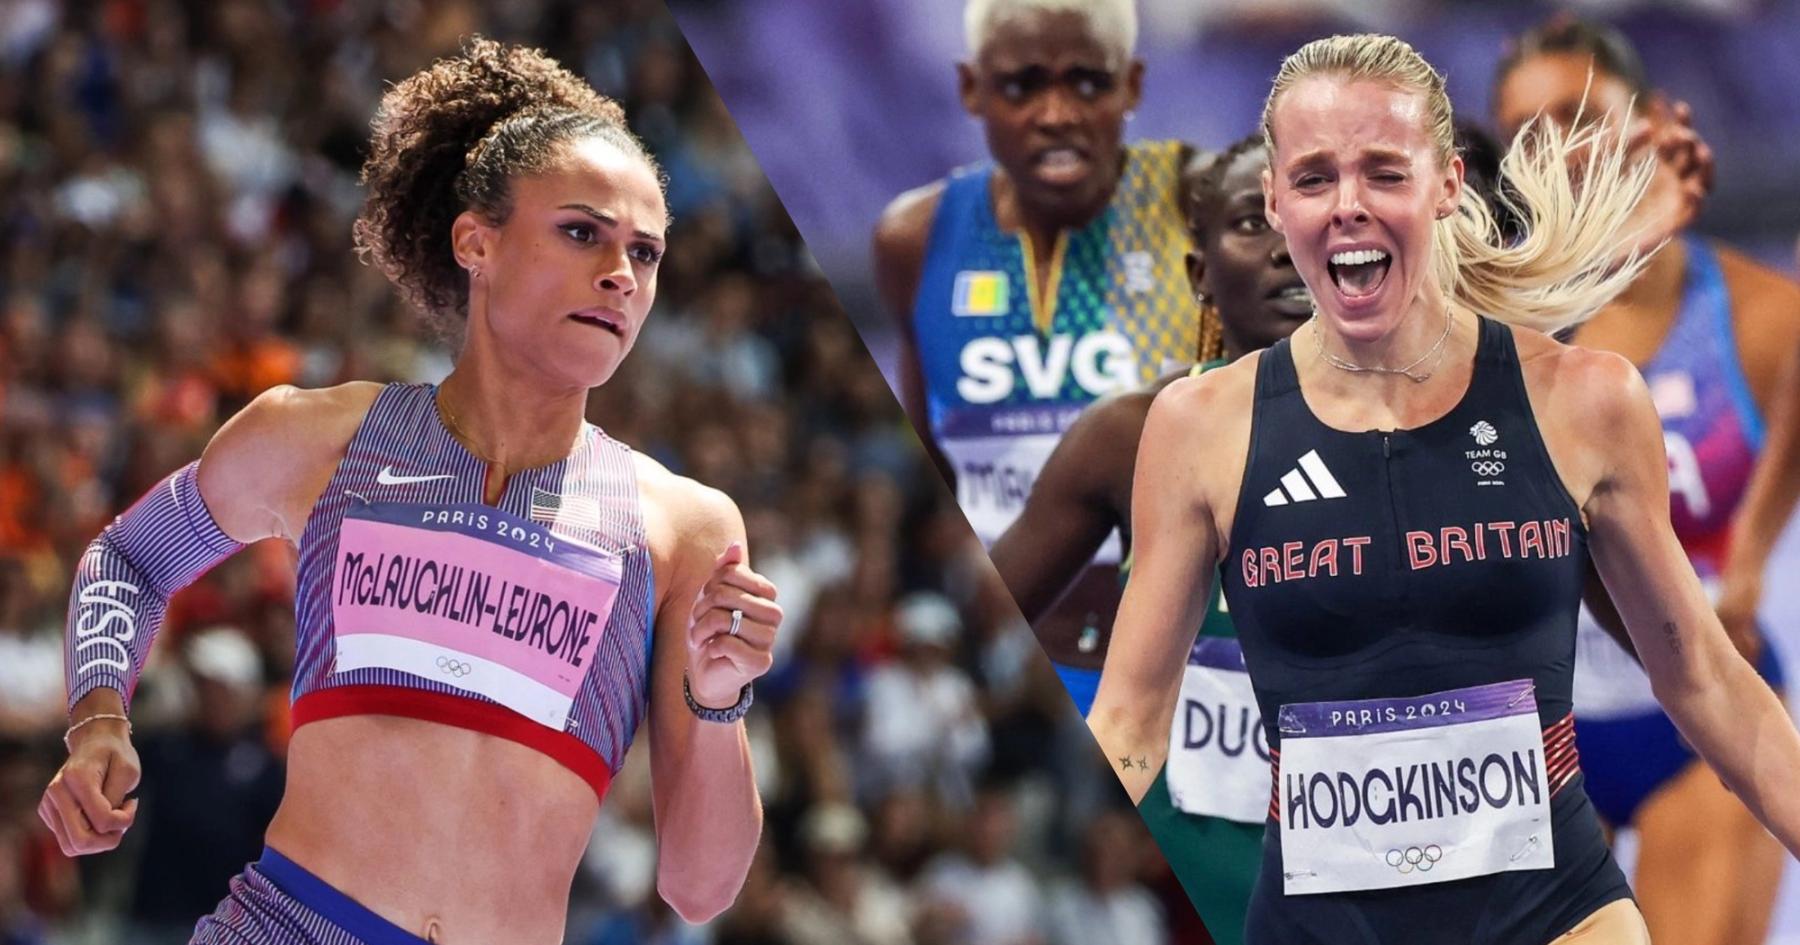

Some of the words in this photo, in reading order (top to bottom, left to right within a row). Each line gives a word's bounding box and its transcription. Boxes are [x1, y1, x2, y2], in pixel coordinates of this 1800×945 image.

[956, 331, 1138, 403] SVG
[1465, 449, 1491, 459] TEAM
[1493, 450, 1507, 459] GB
[422, 510, 489, 530] PARIS
[496, 521, 554, 553] 2024
[1242, 536, 1371, 588] GREAT
[1406, 518, 1569, 570] BRITAIN
[76, 580, 139, 674] USA
[1331, 707, 1396, 727] PARIS
[1405, 699, 1466, 720] 2024
[1286, 749, 1541, 830] HODGKINSON
